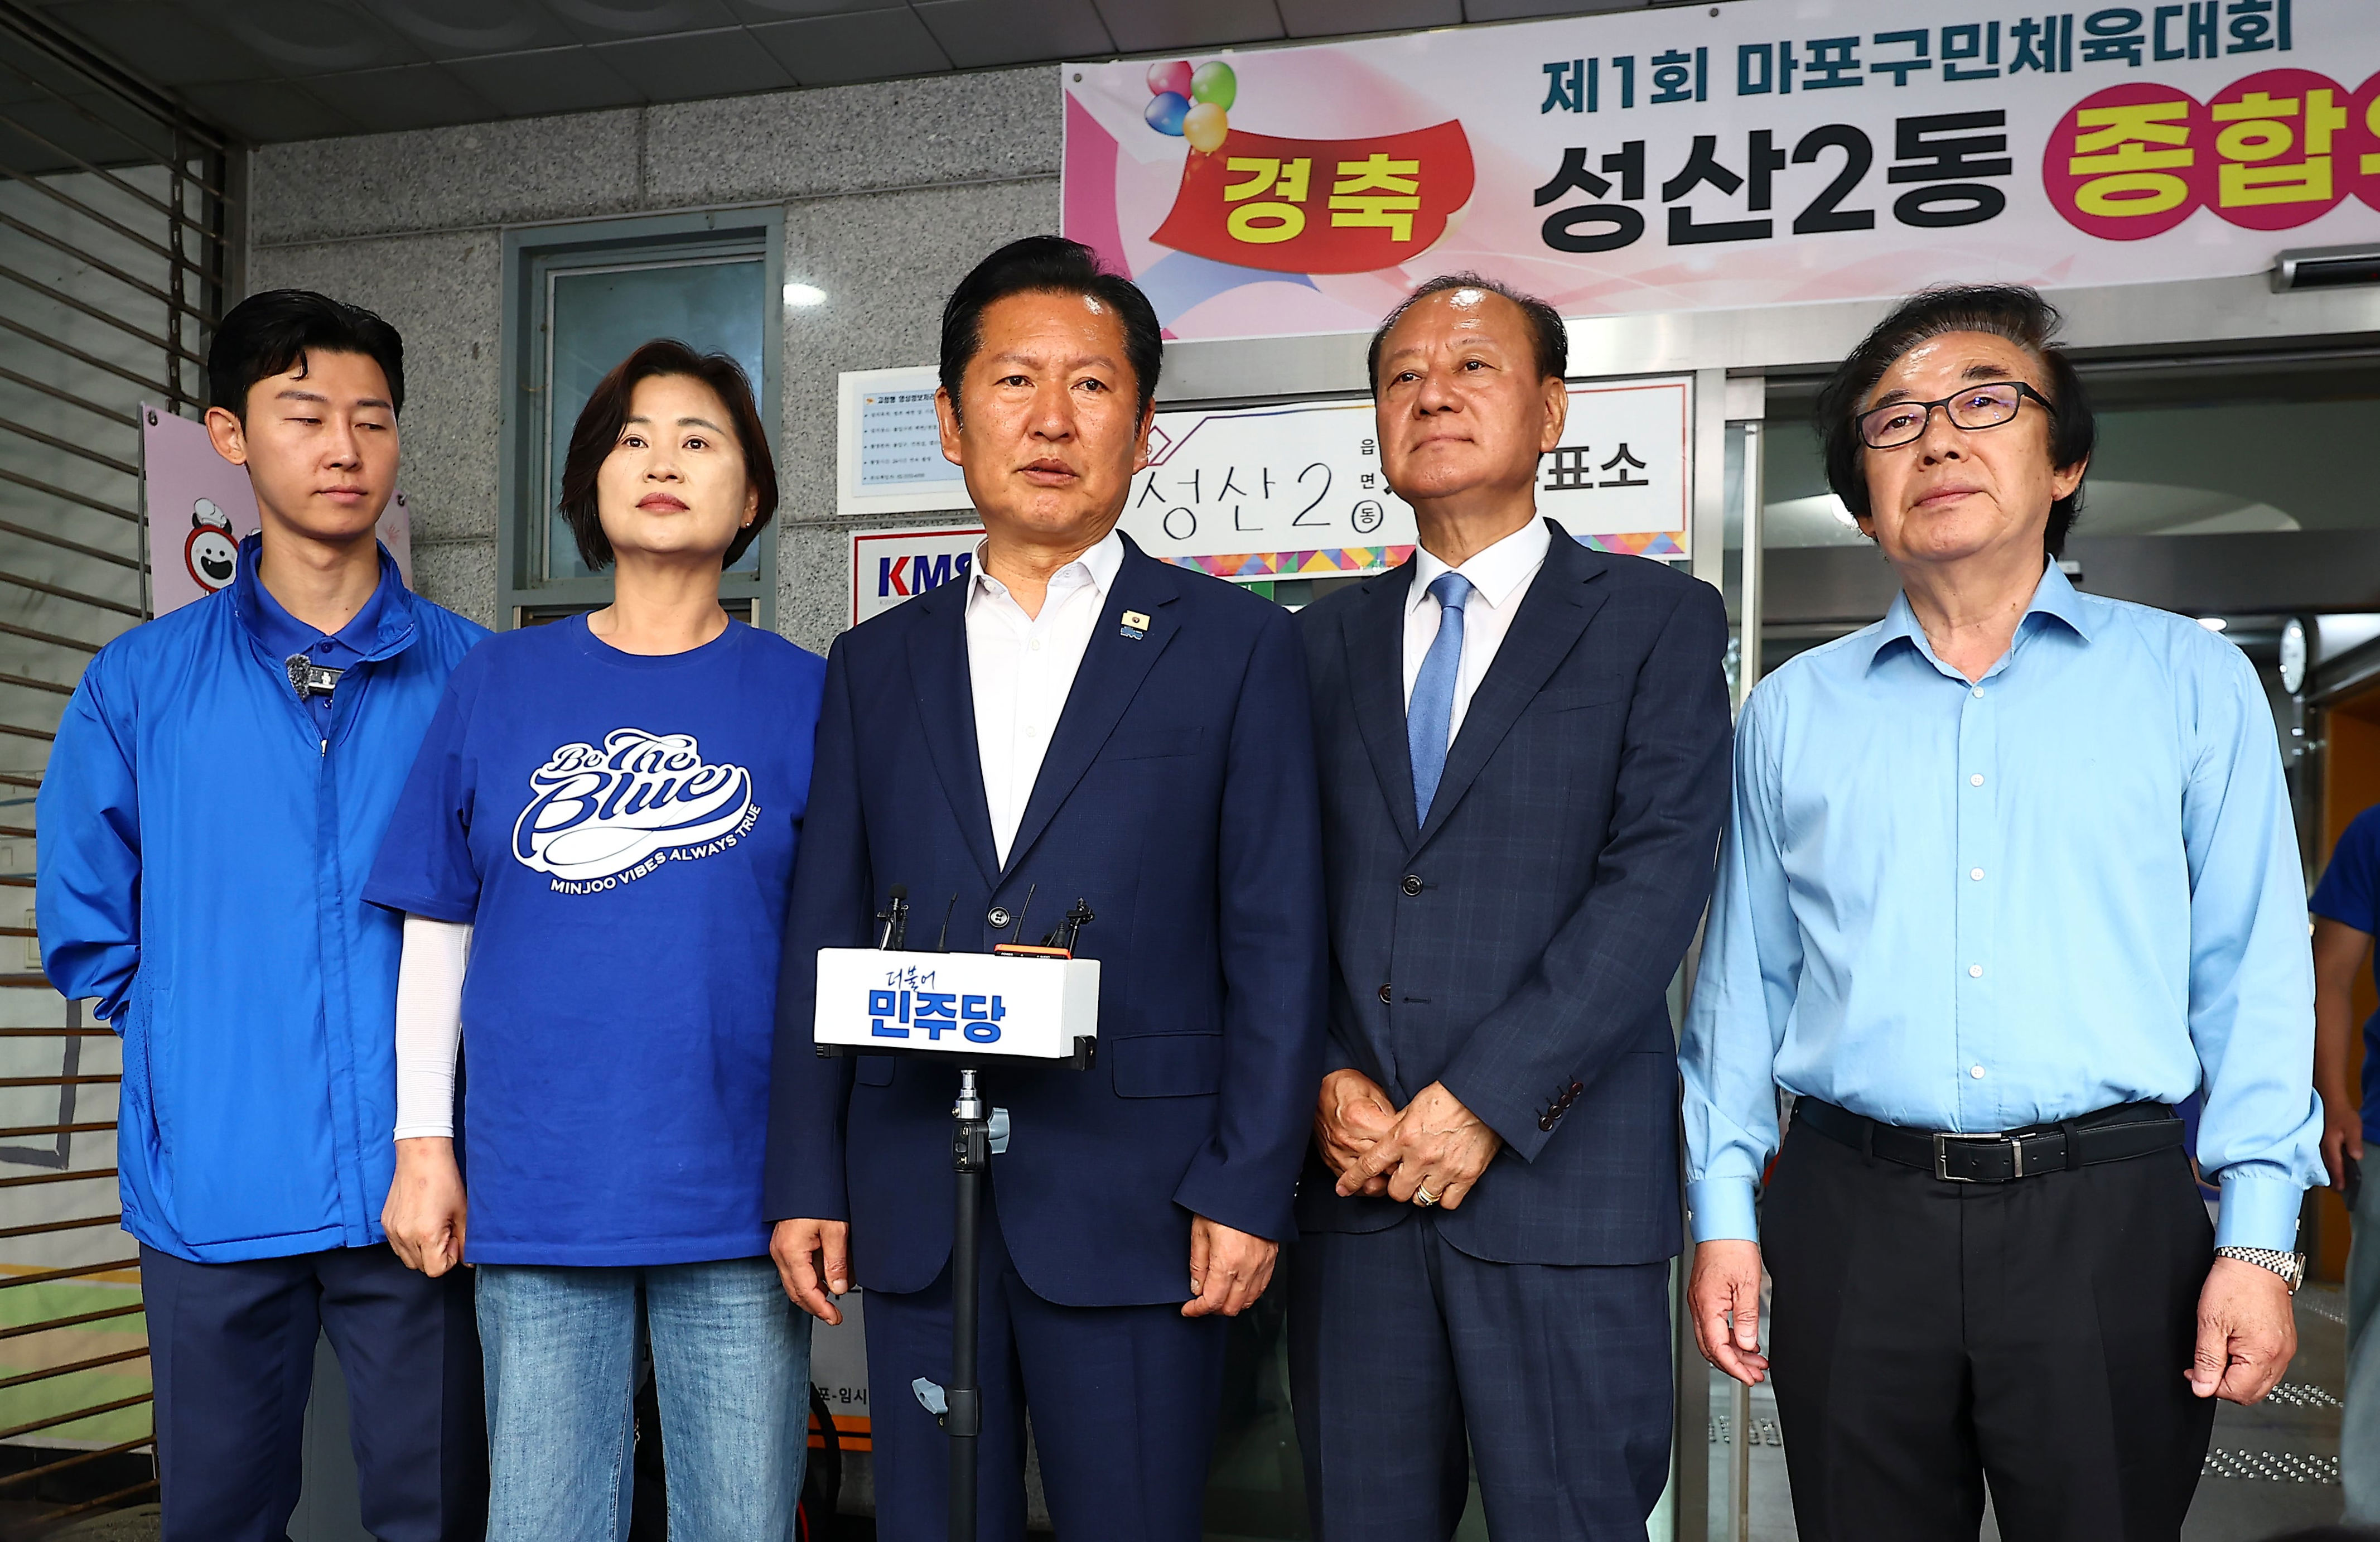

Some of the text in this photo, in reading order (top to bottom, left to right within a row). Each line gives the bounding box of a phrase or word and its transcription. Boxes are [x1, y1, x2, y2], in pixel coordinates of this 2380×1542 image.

[1541, 0, 2292, 114] 제1회 마포구민체육대회
[1224, 153, 1421, 244] 경축
[1533, 109, 2012, 253] 성산2동
[1137, 462, 1332, 539] 성산2
[1536, 443, 1649, 491] 표소
[547, 732, 696, 774] Be The
[516, 768, 748, 865] Blue
[550, 802, 762, 895] MINJOO VIBES ALWAYS TRUE
[868, 990, 1006, 1044] 민주당
[885, 965, 936, 992] 더불어
